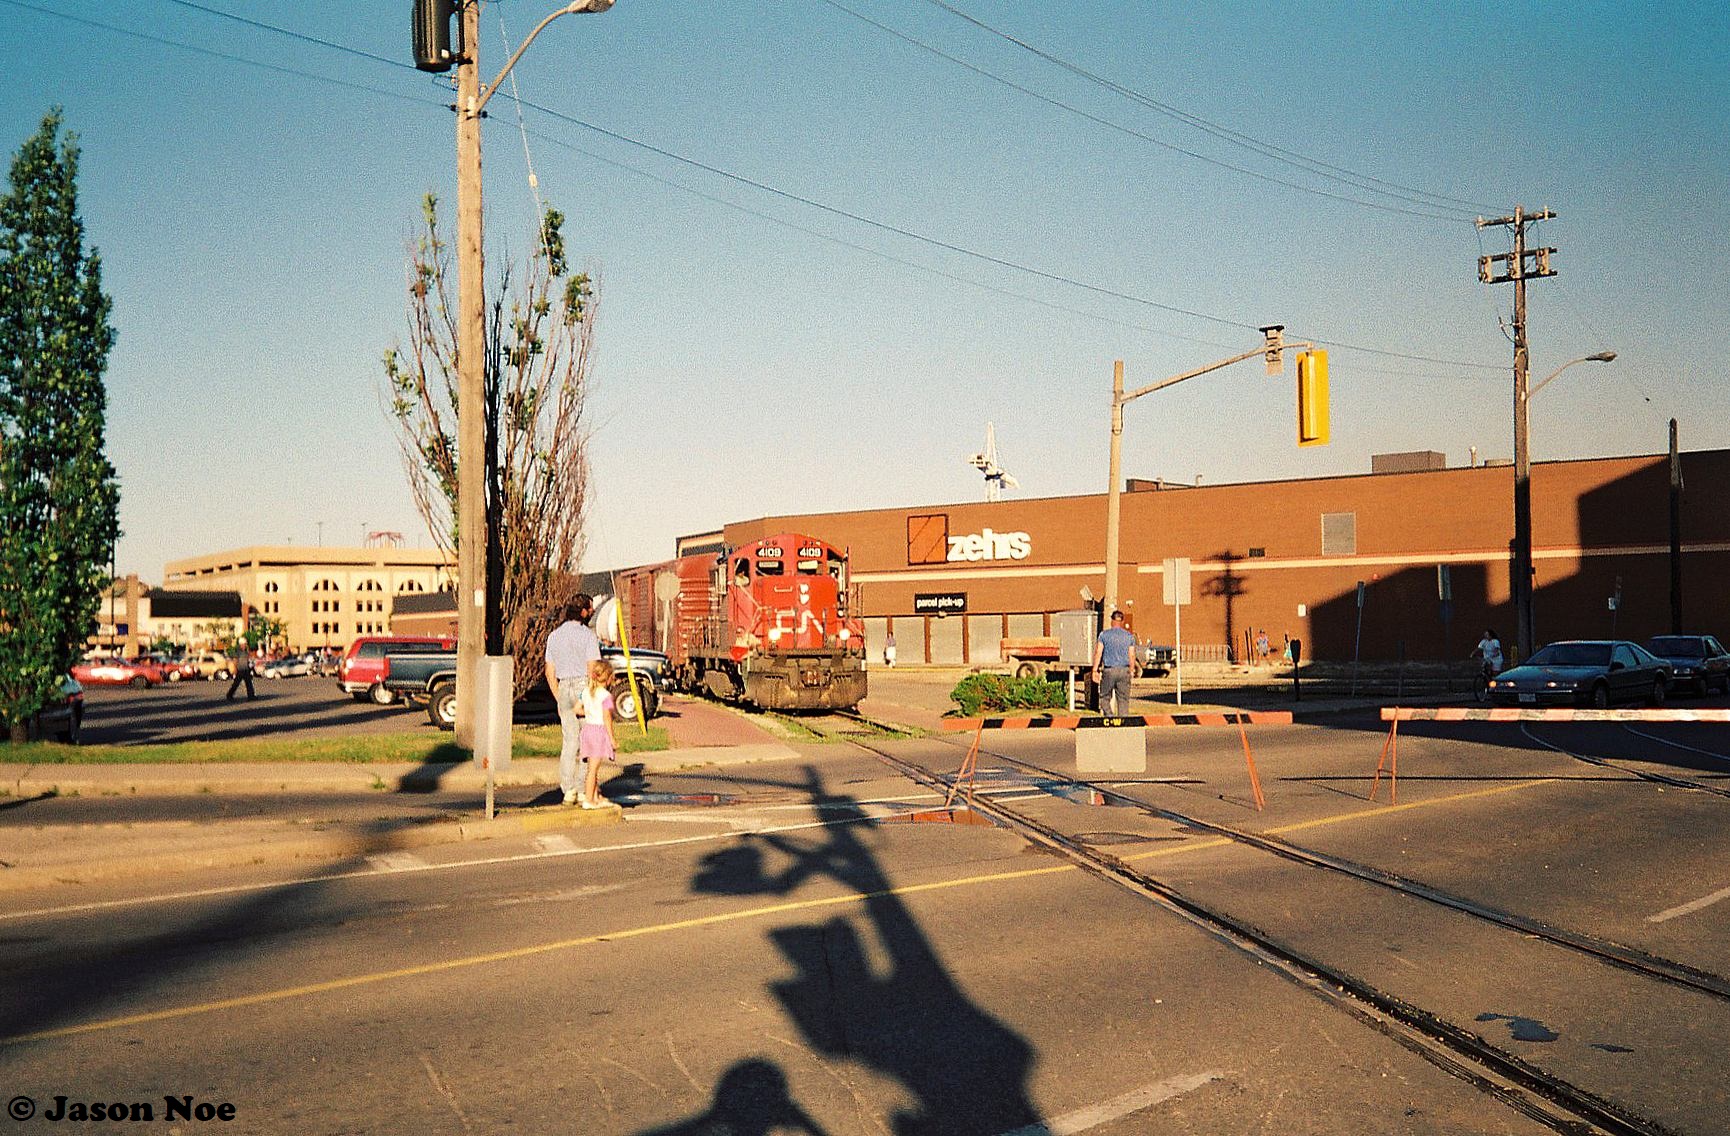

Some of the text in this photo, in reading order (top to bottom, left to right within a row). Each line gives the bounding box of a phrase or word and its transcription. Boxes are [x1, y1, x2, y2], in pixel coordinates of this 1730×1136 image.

[946, 528, 1031, 561] zehrs
[758, 548, 782, 557] 4109
[799, 548, 822, 557] 4109
[916, 596, 964, 609] parcel pick-up
